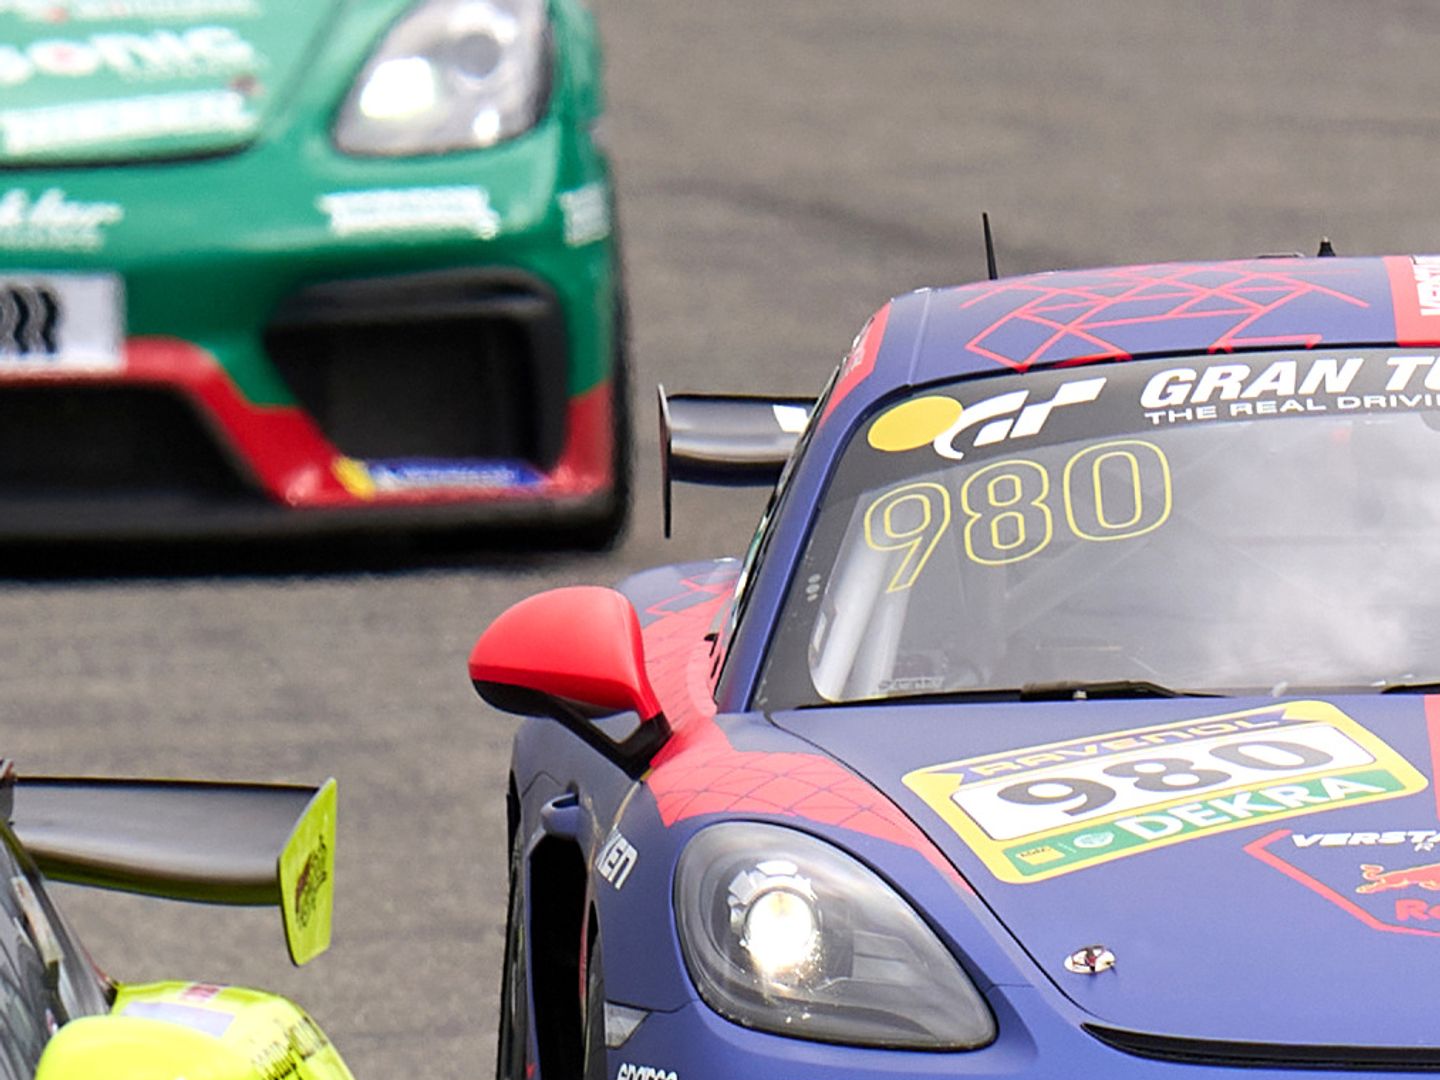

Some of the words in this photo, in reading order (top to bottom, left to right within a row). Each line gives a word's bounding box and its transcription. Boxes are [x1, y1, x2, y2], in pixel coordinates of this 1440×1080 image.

[1140, 358, 1377, 409] GRAN
[1145, 404, 1217, 426] THE
[1229, 397, 1327, 417] REAL
[864, 439, 1173, 594] 980
[971, 717, 1280, 777] RAVENOL
[998, 738, 1335, 817] 980
[1114, 772, 1387, 841] DEKRA
